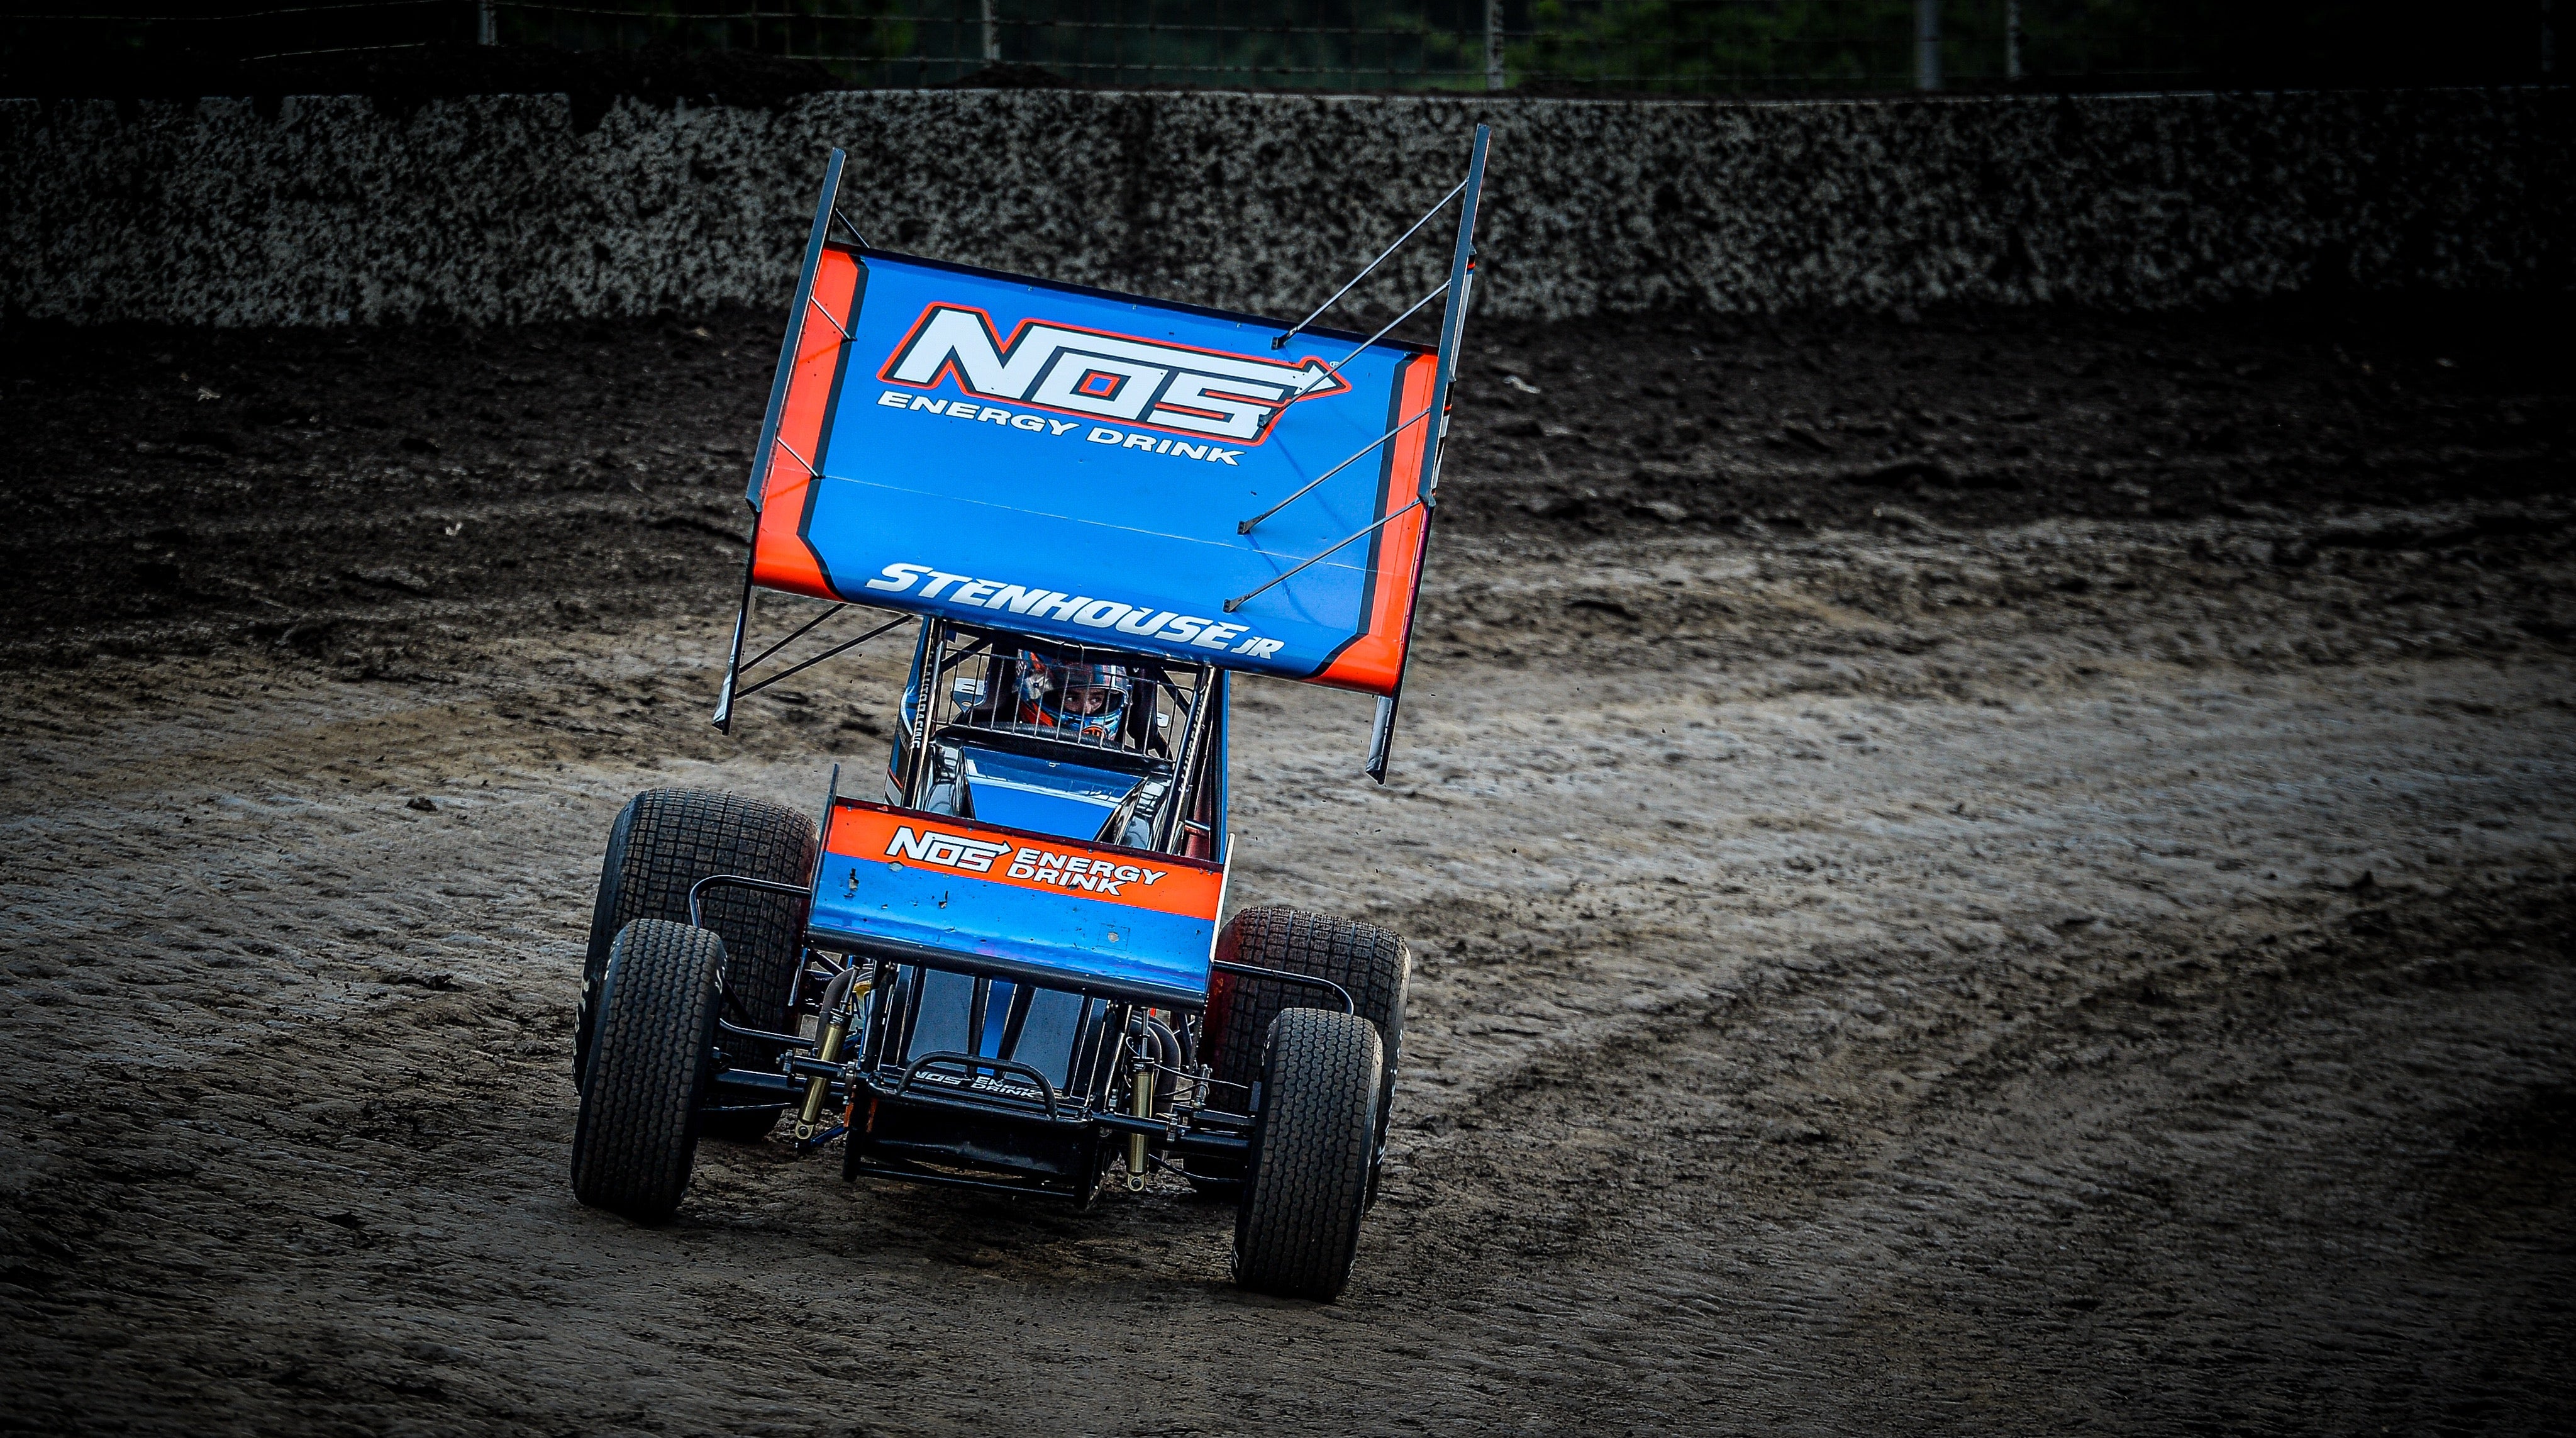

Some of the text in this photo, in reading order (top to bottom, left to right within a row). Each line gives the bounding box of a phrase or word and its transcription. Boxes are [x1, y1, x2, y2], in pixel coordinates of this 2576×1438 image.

[890, 307, 1338, 441] NOS
[877, 390, 1246, 467] ENERGY DRINK
[865, 562, 1250, 650] STENHOUSE
[885, 826, 1168, 886] NOS ENERGY
[1006, 862, 1126, 896] DRINK
[970, 1083, 1035, 1098] DRINK
